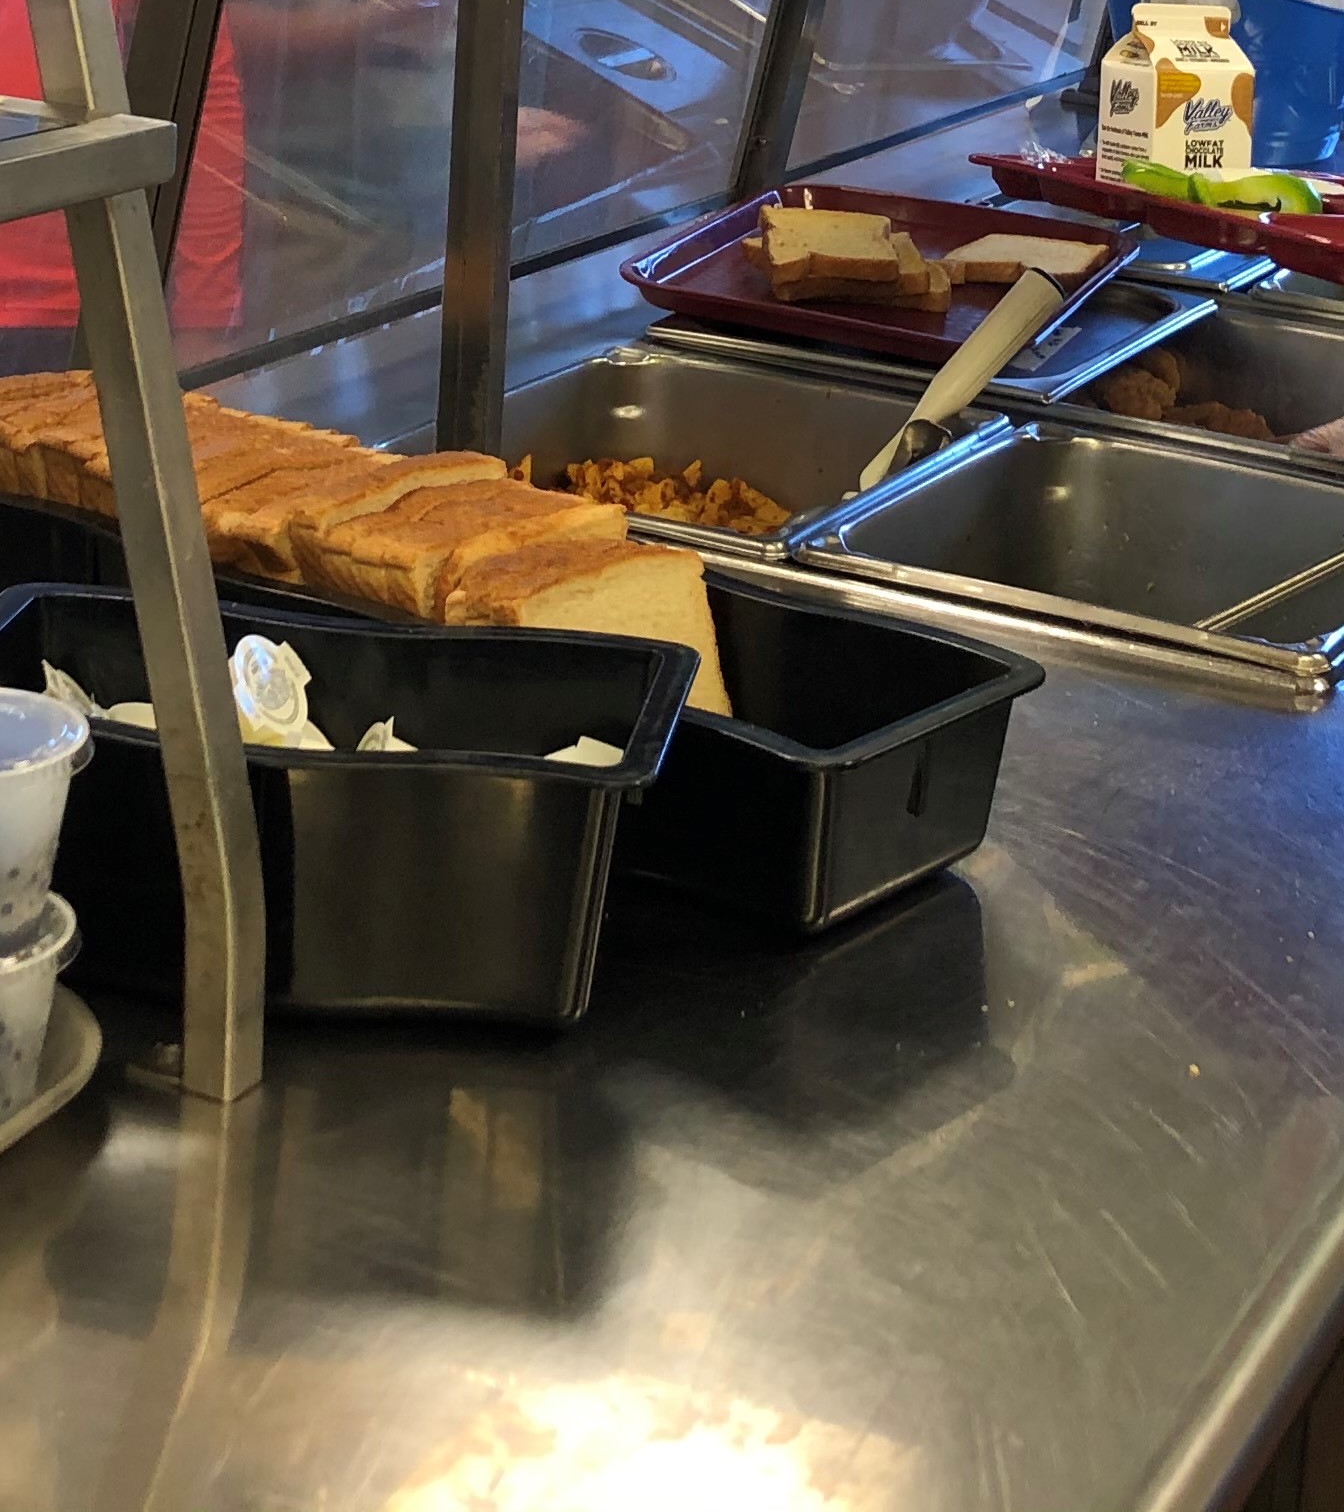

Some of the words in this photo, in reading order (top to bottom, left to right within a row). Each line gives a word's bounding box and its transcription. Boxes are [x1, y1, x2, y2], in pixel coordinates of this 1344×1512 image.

[1184, 98, 1232, 125] Valley
[1185, 121, 1218, 135] Farms
[1185, 139, 1225, 148] LOWFAT
[1185, 148, 1224, 156] CHOCOLATE
[1185, 155, 1223, 169] MILK
